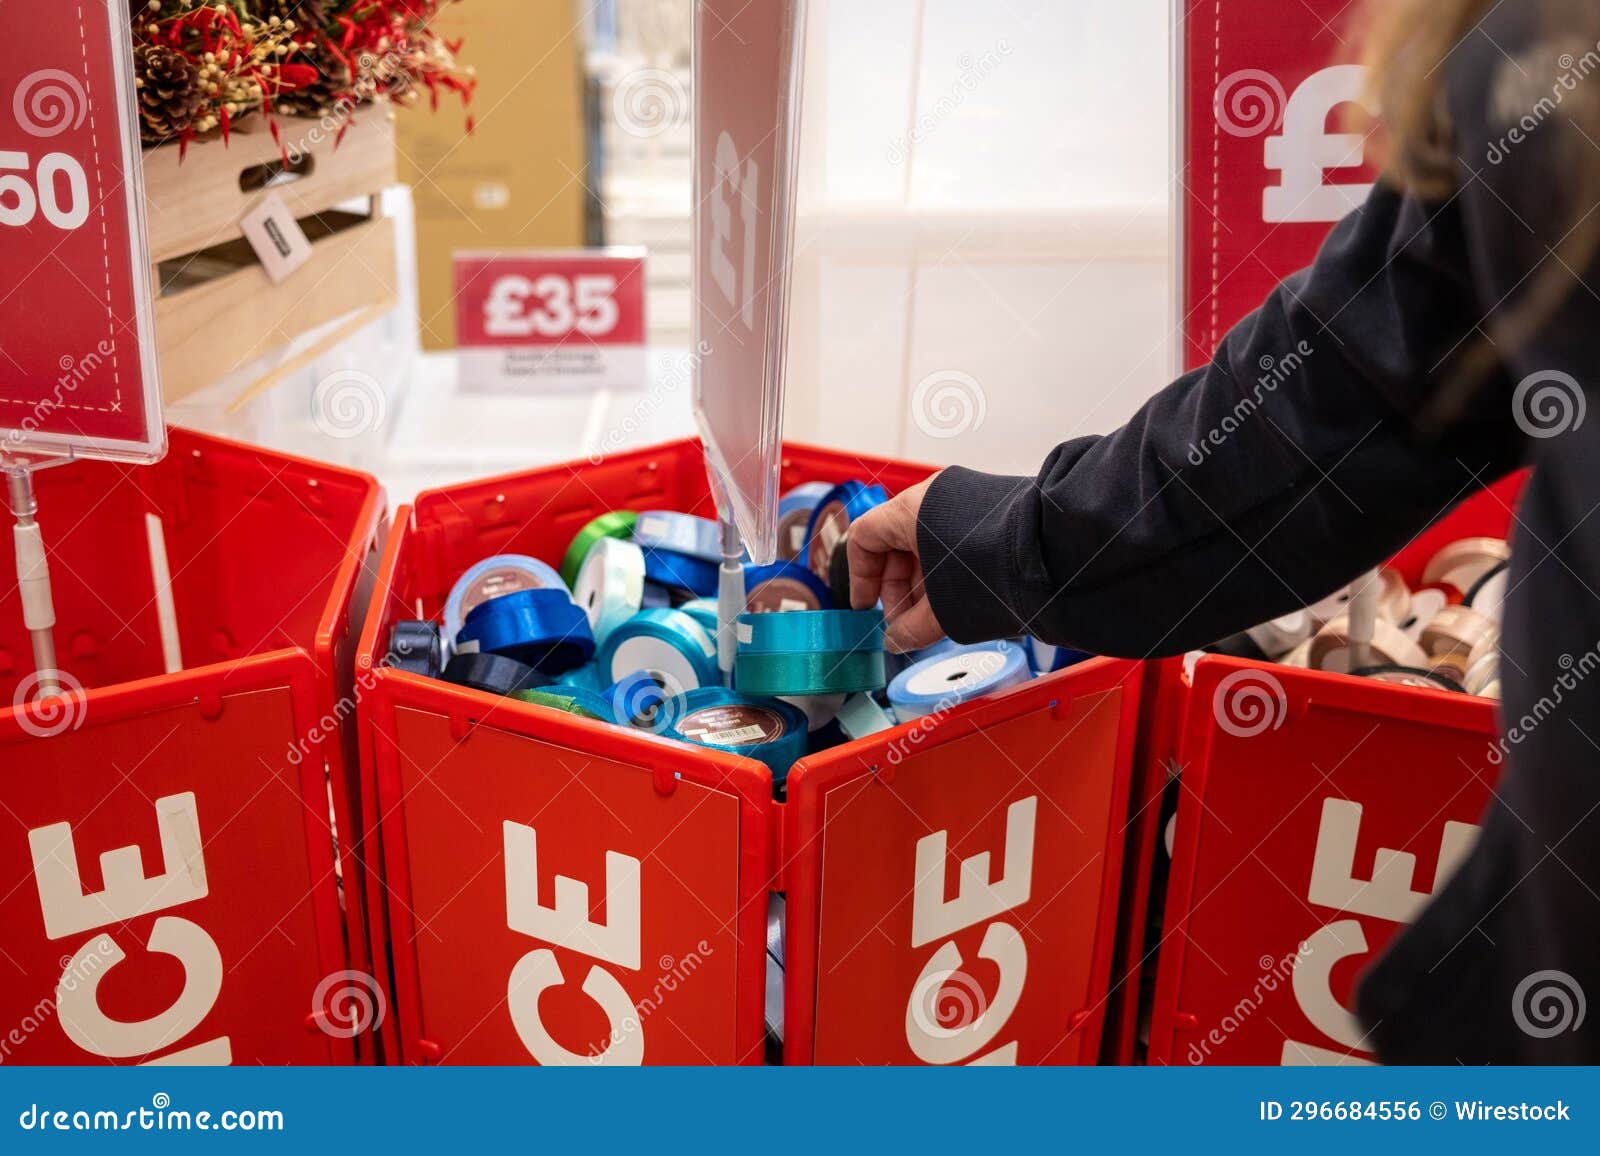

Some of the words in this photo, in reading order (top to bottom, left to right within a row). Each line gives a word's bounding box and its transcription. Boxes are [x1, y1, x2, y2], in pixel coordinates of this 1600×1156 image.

[483, 274, 620, 337] £35
[711, 130, 758, 332] £1
[905, 795, 1038, 1066] CE
